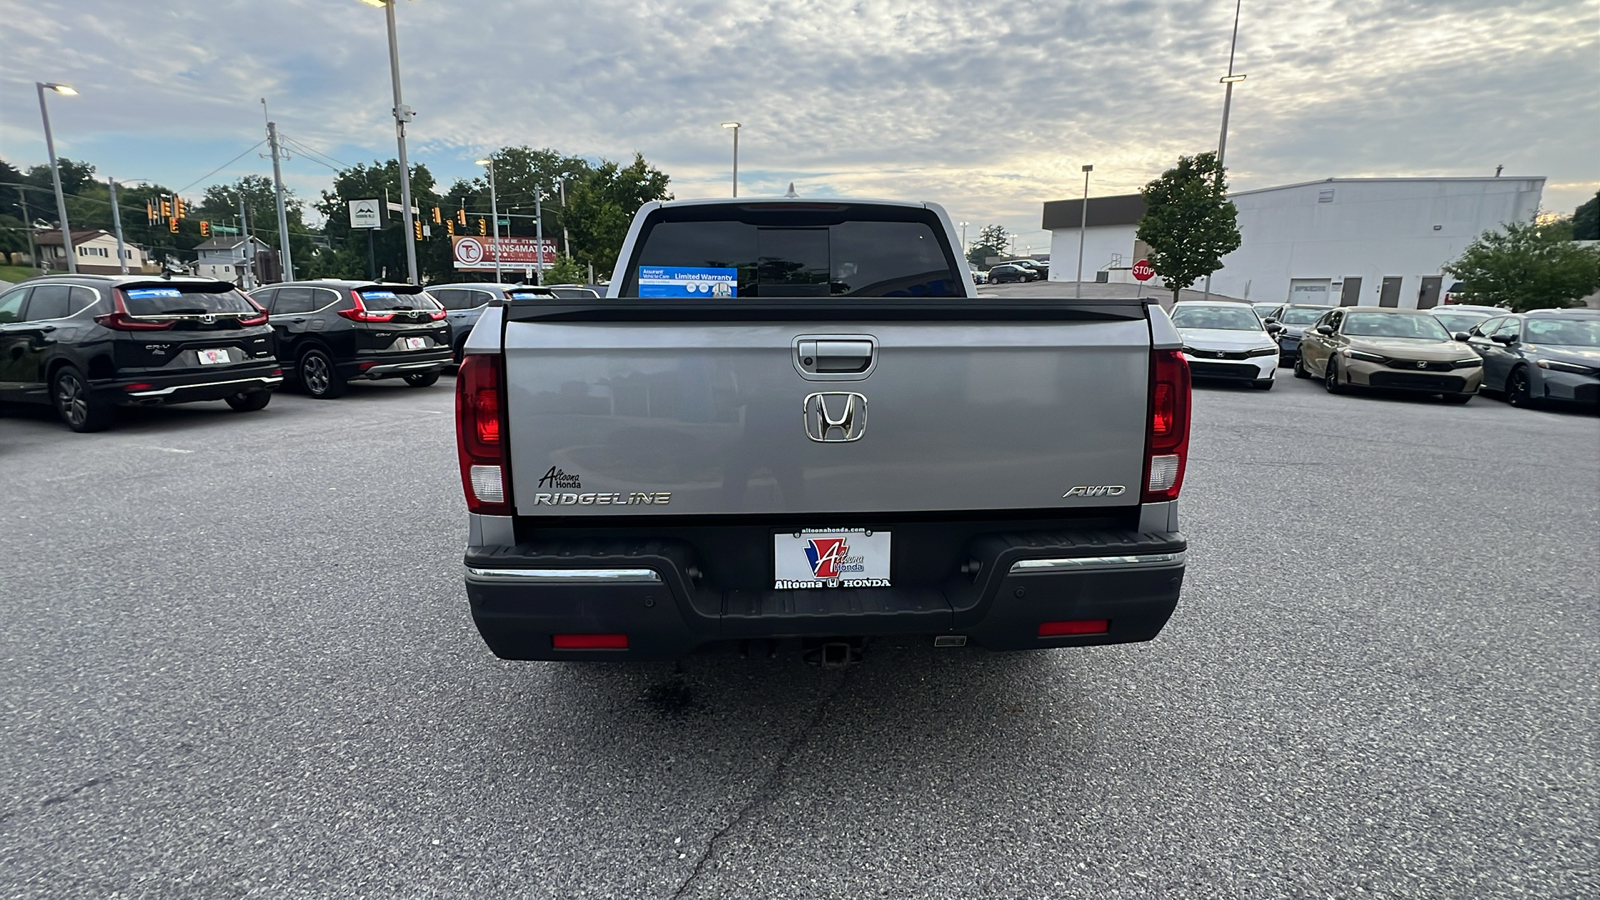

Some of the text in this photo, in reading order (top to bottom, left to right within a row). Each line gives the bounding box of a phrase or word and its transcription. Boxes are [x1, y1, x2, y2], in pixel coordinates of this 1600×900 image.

[484, 244, 556, 253] TRANS4MATON
[1133, 265, 1155, 276] STOP
[538, 465, 580, 489] Altoona
[556, 481, 581, 489] Honda
[1062, 485, 1126, 498] AWD
[533, 492, 672, 506] RIDGELINE
[834, 562, 865, 573] Honda
[774, 579, 892, 590] Altoona HONDA
